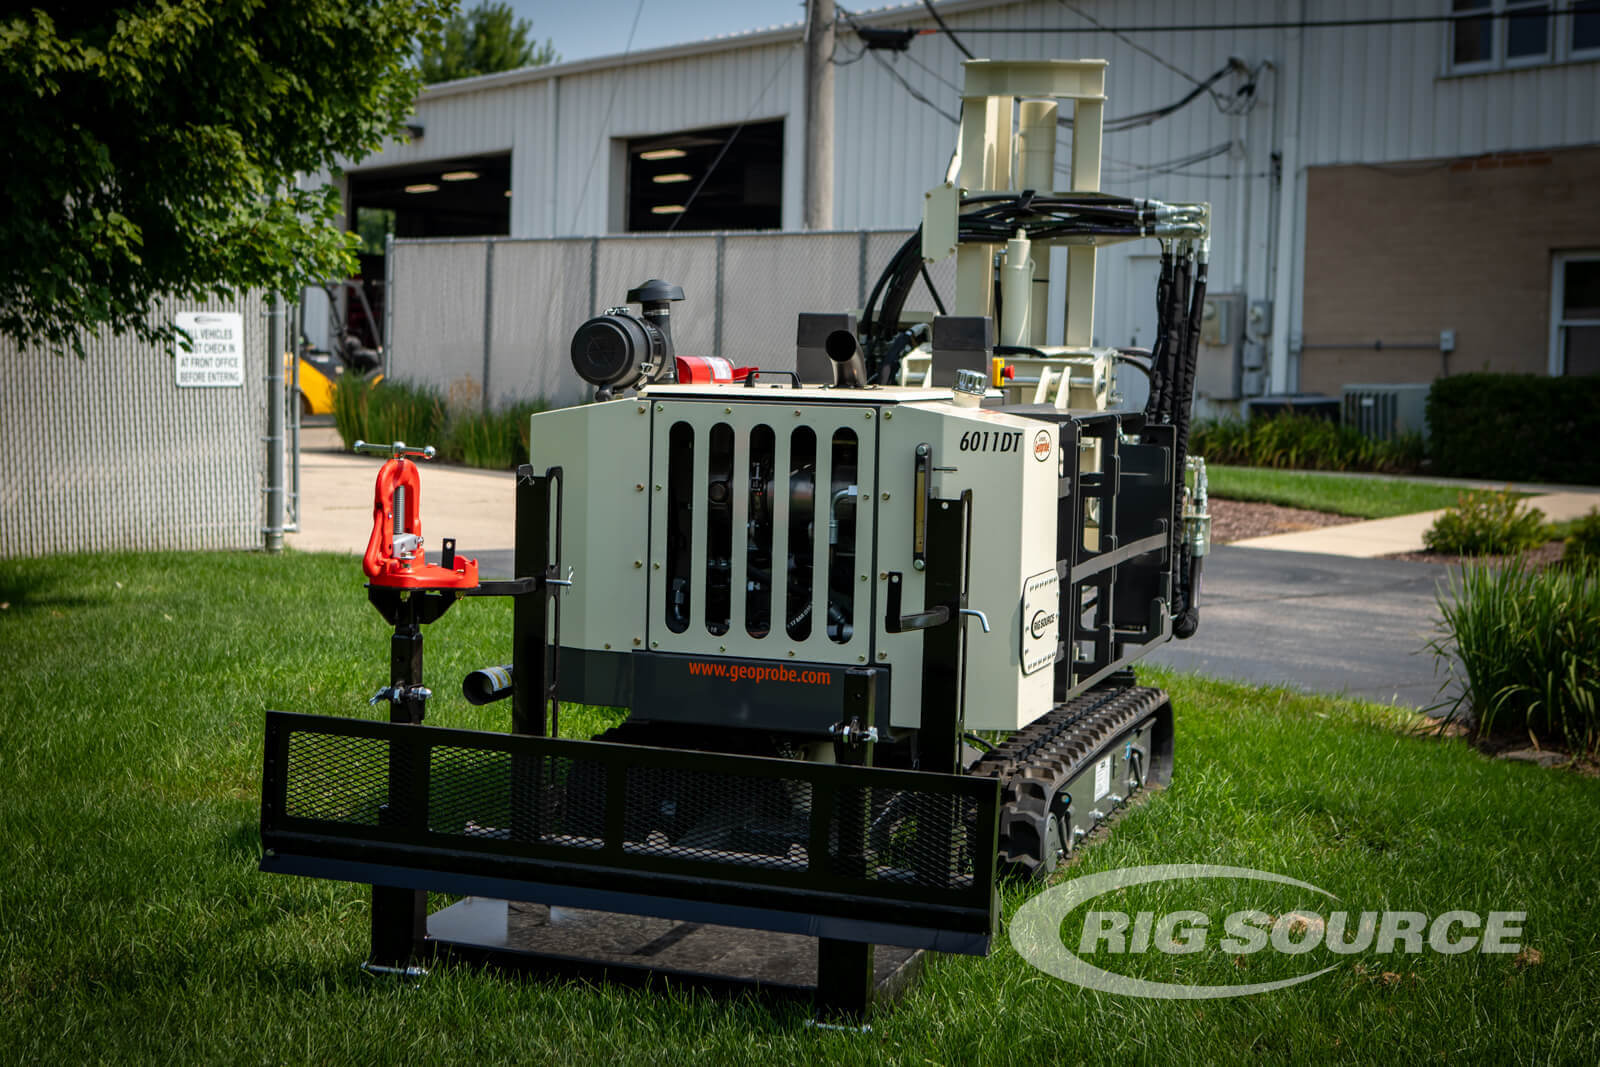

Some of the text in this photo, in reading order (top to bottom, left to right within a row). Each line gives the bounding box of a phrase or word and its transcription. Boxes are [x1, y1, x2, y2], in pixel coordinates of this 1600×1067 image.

[200, 328, 232, 339] VEHICLES
[204, 343, 227, 353] CHECK
[229, 343, 236, 353] IN
[181, 357, 238, 368] AT FRONT OFFICE
[180, 371, 239, 382] BEFORE ENTERING
[960, 431, 1023, 452] 6011DT
[1041, 613, 1055, 629] SOURCE
[688, 662, 831, 685] www.geoprobe.com
